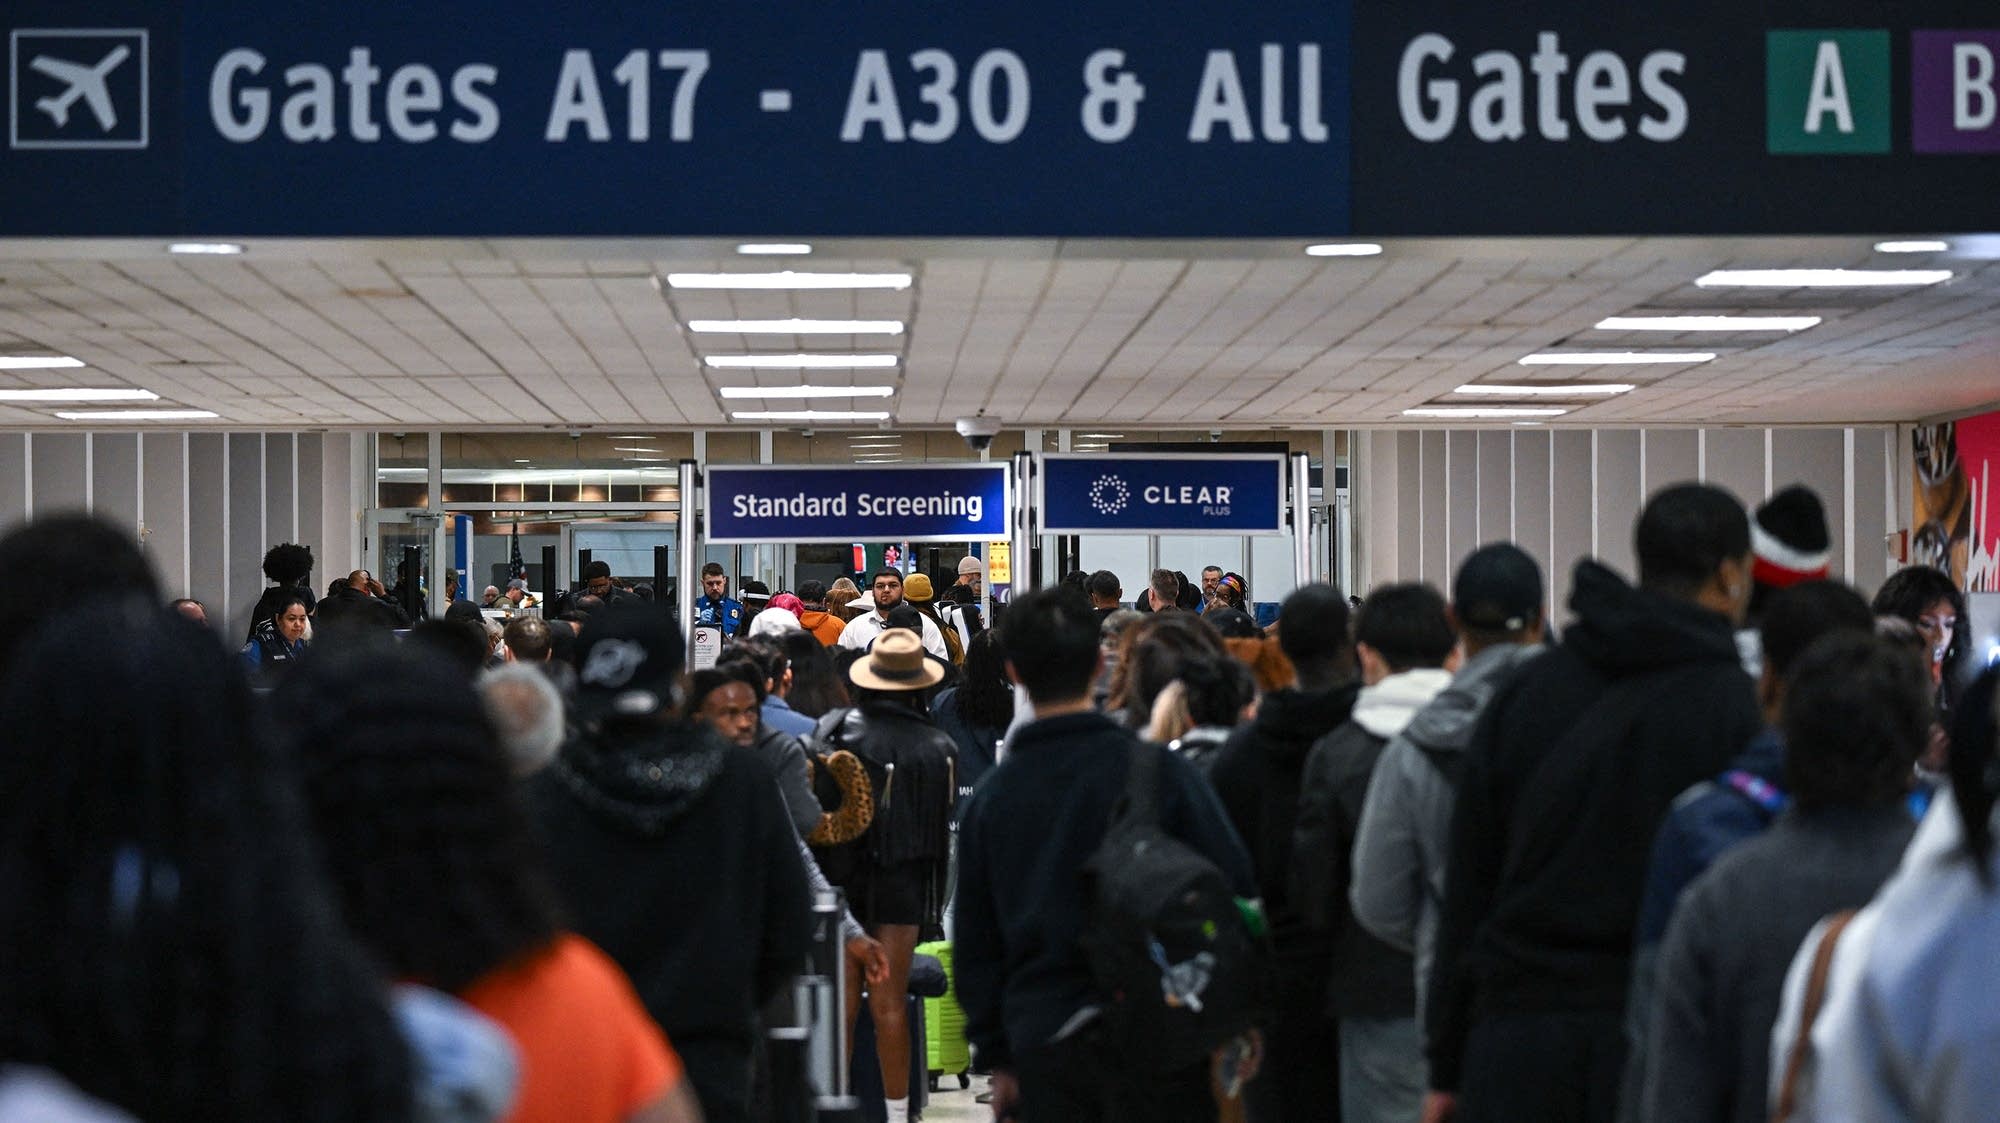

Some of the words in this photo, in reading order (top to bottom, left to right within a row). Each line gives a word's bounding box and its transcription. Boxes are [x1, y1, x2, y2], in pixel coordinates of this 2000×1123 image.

[208, 47, 500, 143] Gates
[545, 50, 711, 142] A17
[759, 89, 793, 112] -
[840, 50, 1030, 143] A30
[1080, 50, 1146, 143] &
[1187, 44, 1329, 143] All
[1398, 32, 1689, 142] Gates
[1803, 41, 1855, 133] A
[1953, 42, 1996, 131] B
[732, 491, 848, 518] Standard
[856, 490, 983, 522] Screening
[1143, 485, 1231, 504] CLEAR
[1202, 505, 1231, 516] PLUS
